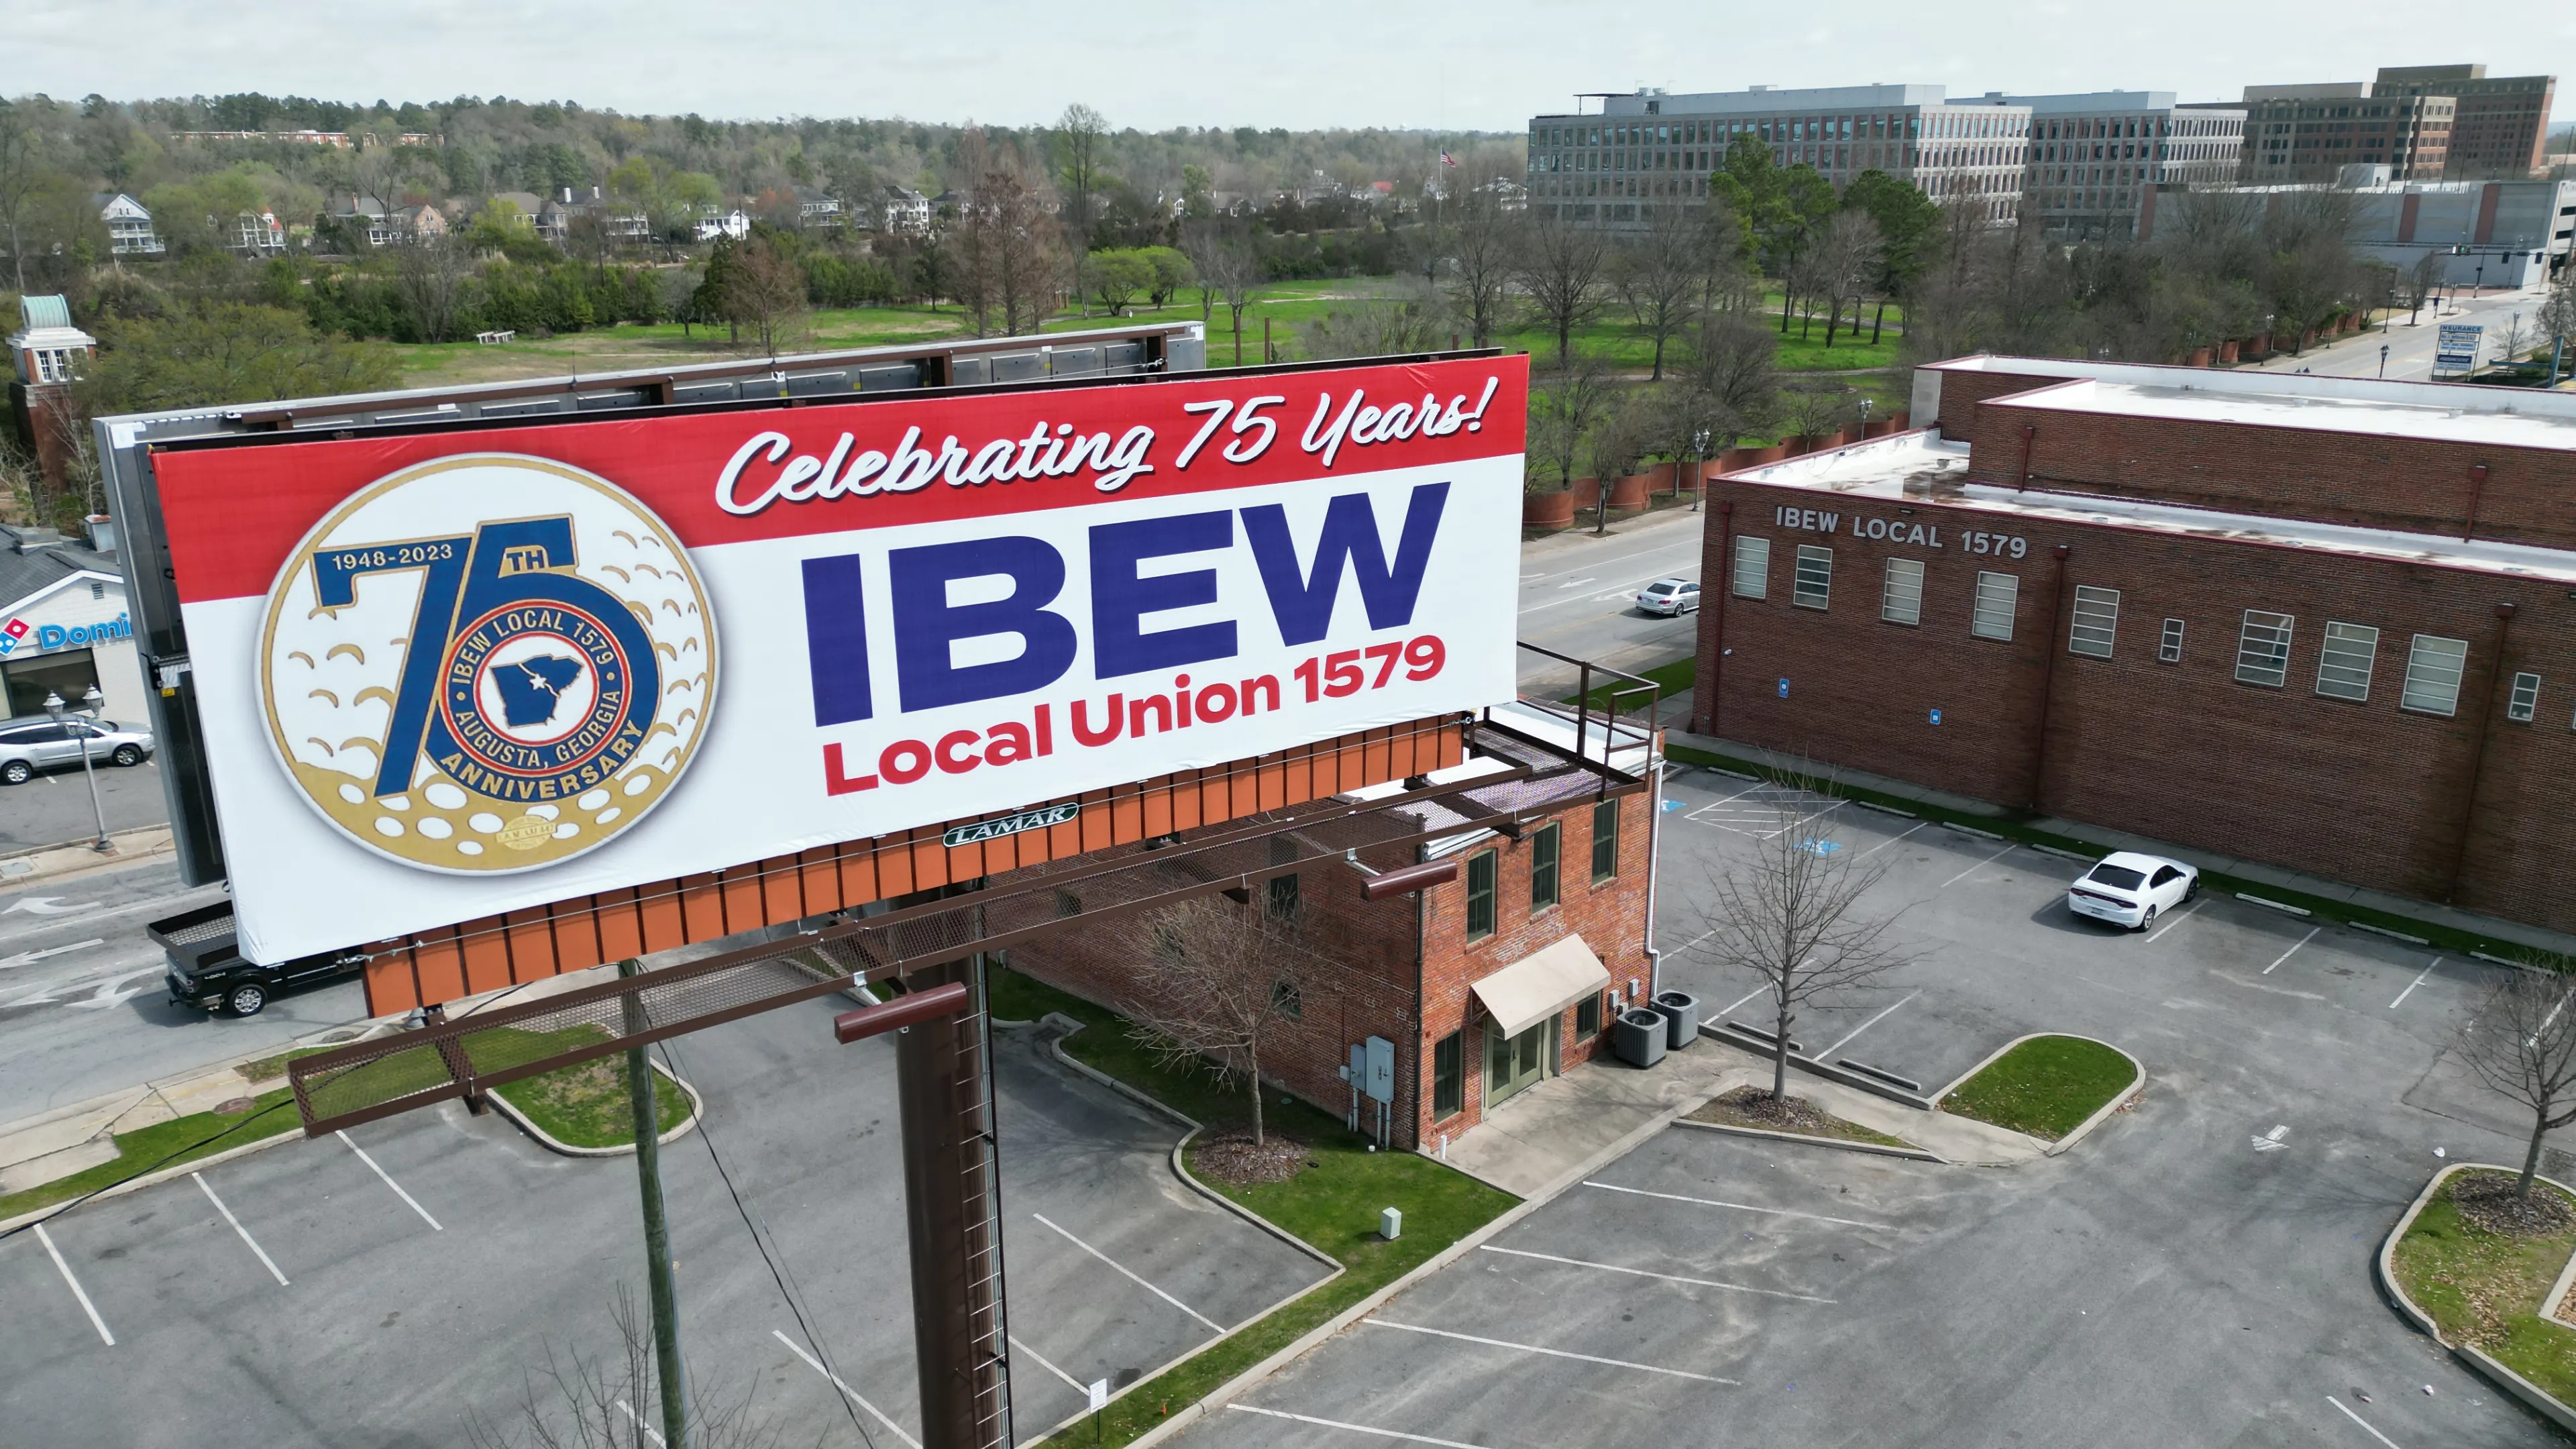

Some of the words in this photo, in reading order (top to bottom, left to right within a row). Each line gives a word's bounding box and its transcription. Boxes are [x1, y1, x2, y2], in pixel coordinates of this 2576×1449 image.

[715, 421, 1155, 515] Celebrating
[1175, 396, 1285, 468] 75
[1301, 376, 1499, 468] Years!
[332, 544, 453, 570] 1948-2023
[506, 550, 545, 571] TH
[1776, 506, 1839, 533] IBEW
[1853, 517, 1943, 547] LOCAL
[1961, 531, 2027, 559] 1579
[38, 612, 132, 650] Domi
[801, 482, 1452, 727] IBEW
[451, 631, 492, 684] IBEW
[492, 610, 564, 637] LOCAL
[573, 622, 614, 665] 1579
[455, 710, 549, 769] AUGUSTA,
[555, 690, 620, 762] GEORGIA
[824, 704, 1053, 796] Local
[1071, 674, 1281, 747] Union
[1293, 635, 1446, 704] 1579
[440, 720, 643, 800] ANNIVERSARY
[955, 807, 1066, 843] LAMAR
